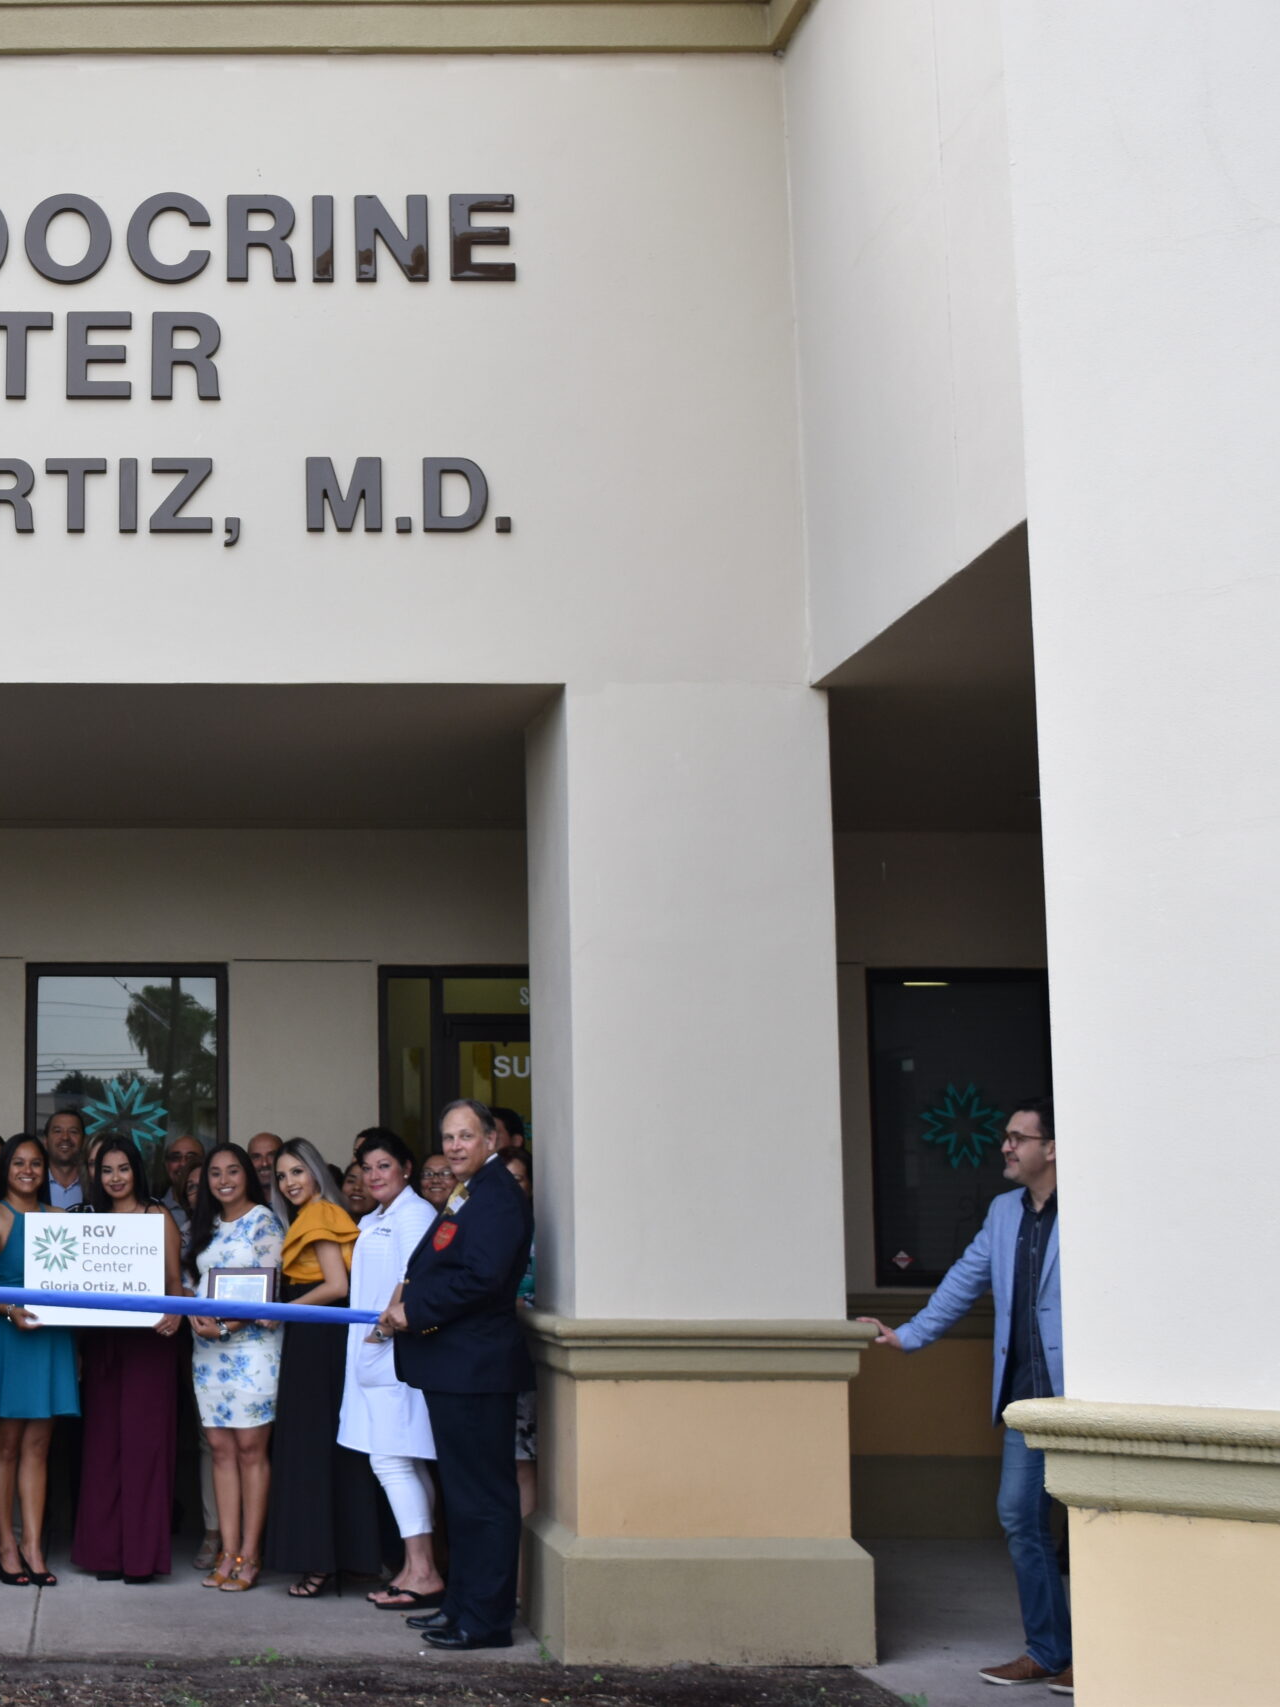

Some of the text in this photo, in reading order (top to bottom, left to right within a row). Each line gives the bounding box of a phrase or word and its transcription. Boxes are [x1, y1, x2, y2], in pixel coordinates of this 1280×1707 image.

[305, 456, 513, 536] M.D.
[82, 1224, 116, 1238] RGV
[82, 1242, 158, 1256] Endocrine
[82, 1259, 133, 1273] Center
[40, 1280, 151, 1292] Gloria Ortiz, M.D.
